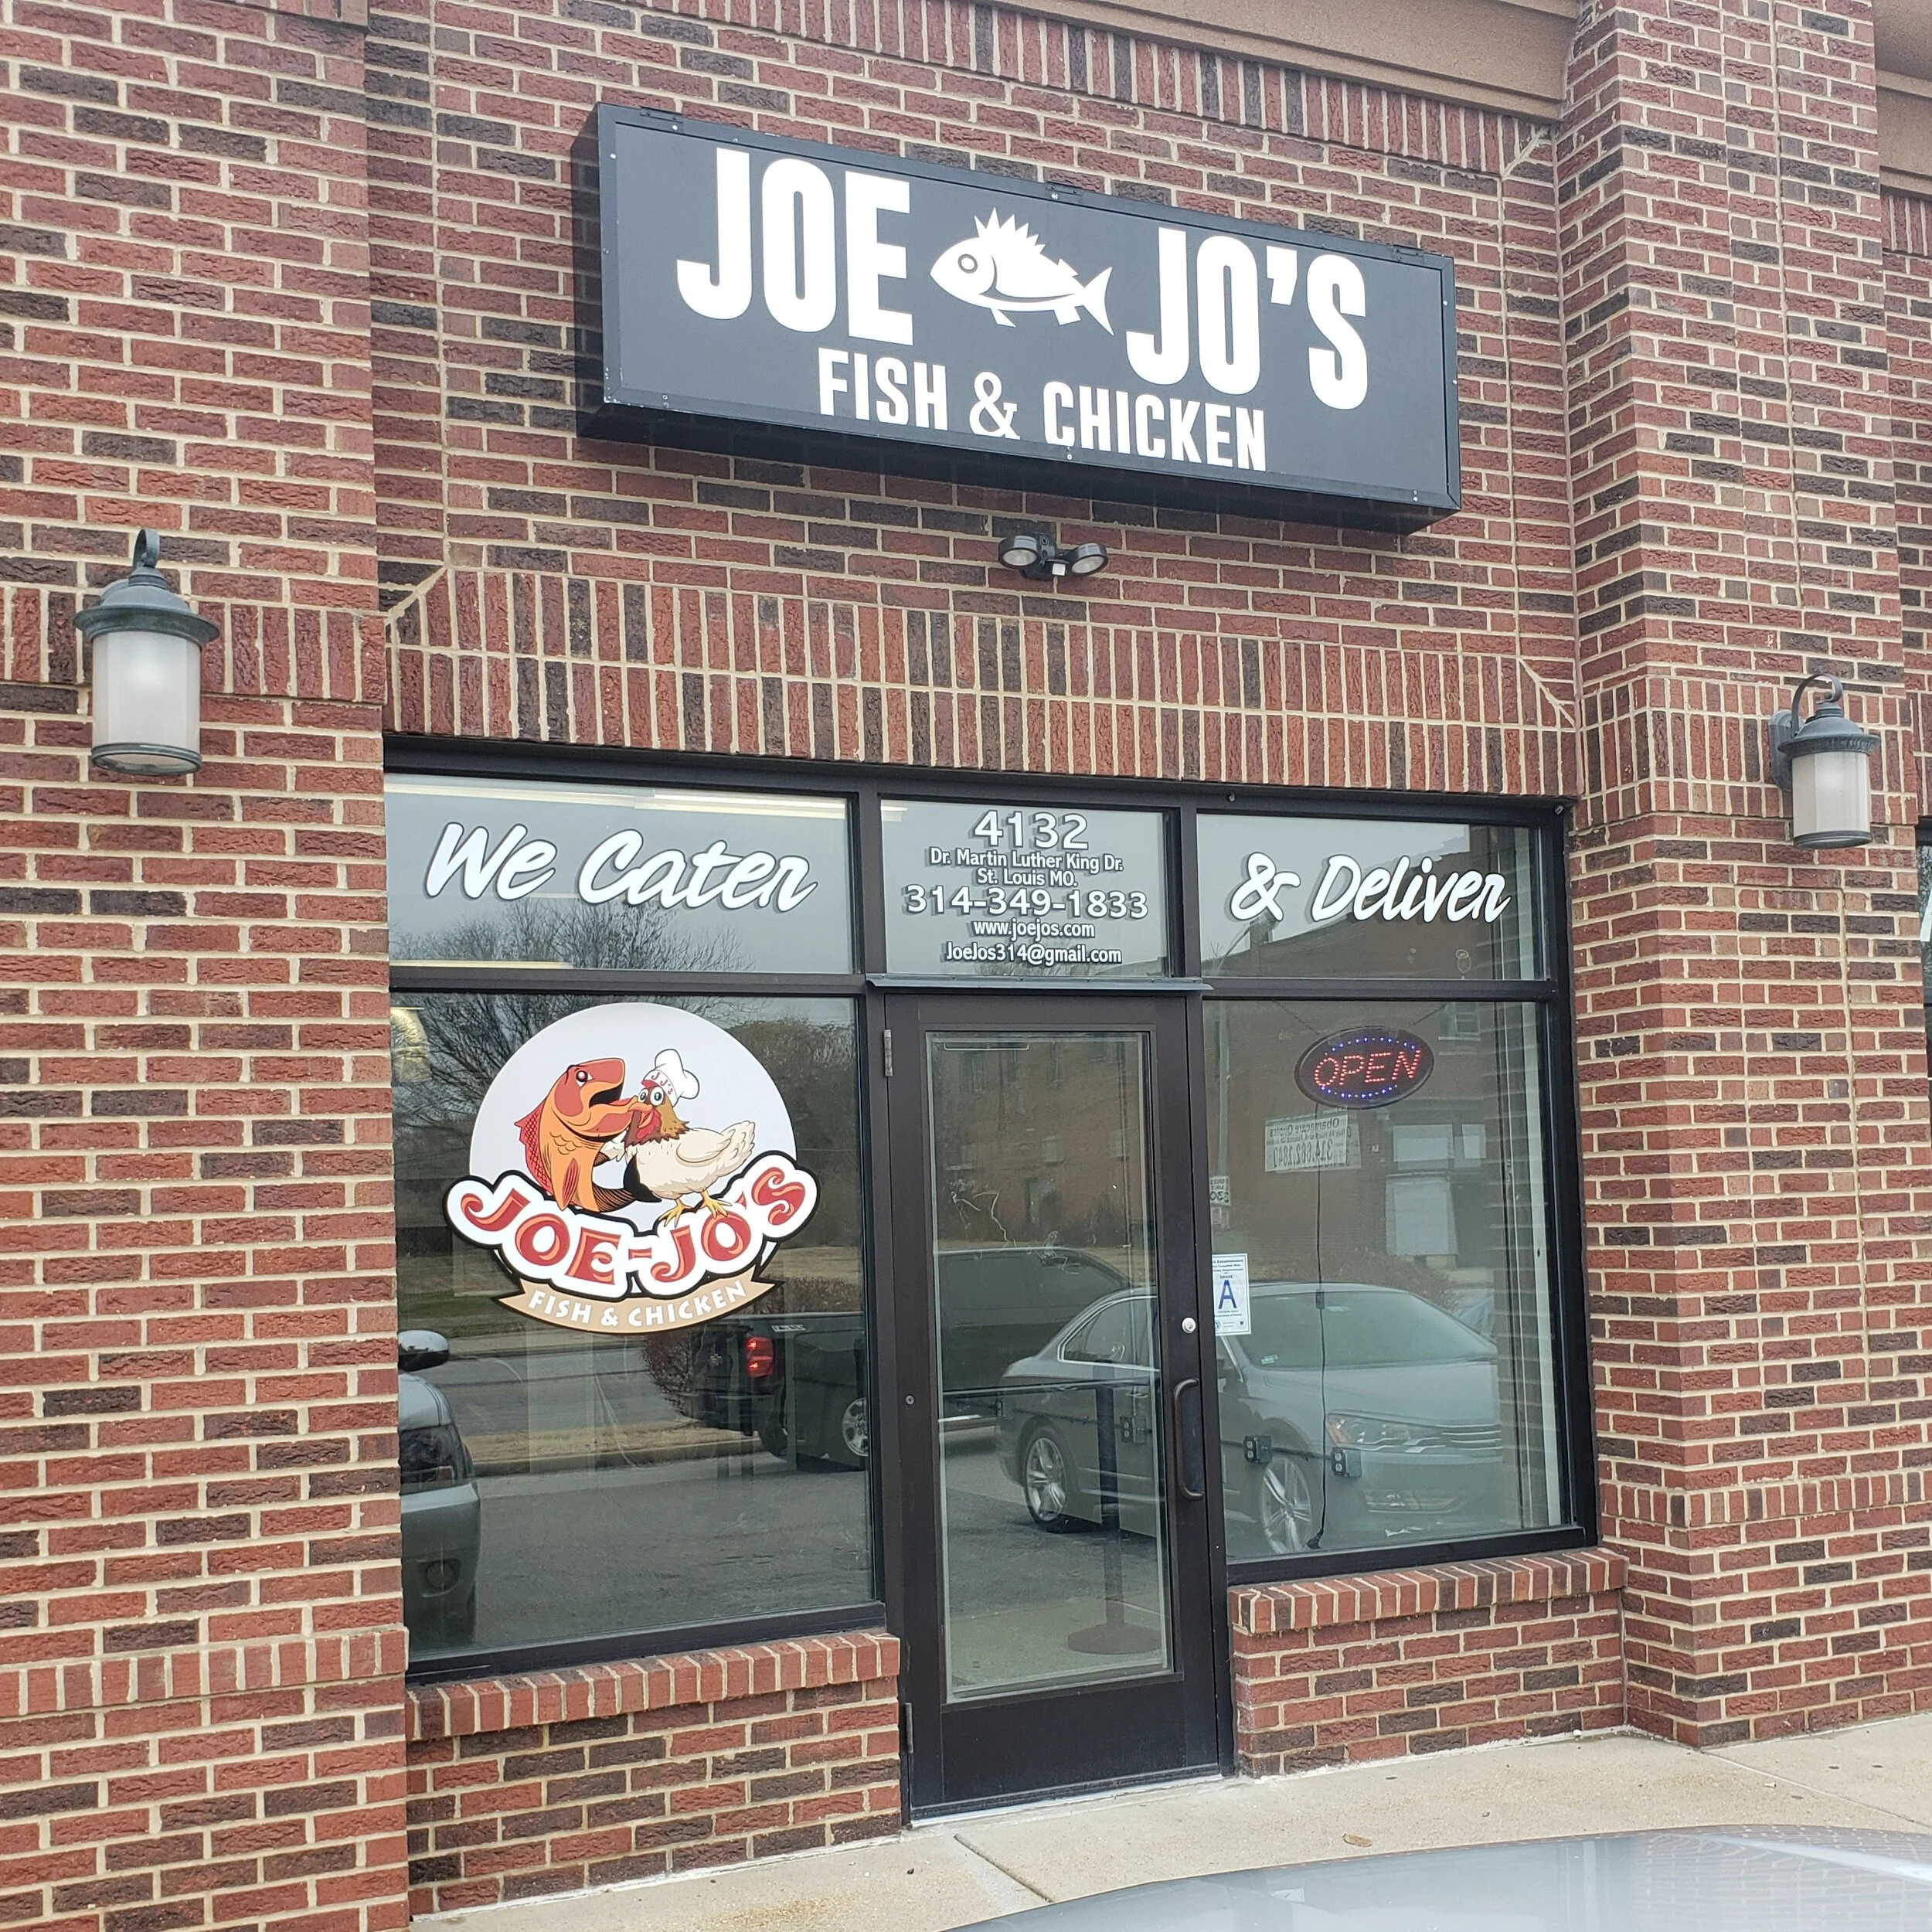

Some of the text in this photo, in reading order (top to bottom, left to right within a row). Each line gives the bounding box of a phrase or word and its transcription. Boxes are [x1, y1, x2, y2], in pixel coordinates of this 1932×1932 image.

[677, 148, 1368, 410] JOE JO'S
[818, 347, 1266, 471] FISH & CHICKEN
[972, 810, 1089, 850] 4132
[424, 821, 818, 913] We Cater
[930, 847, 1124, 874] Dr. Martin Luther King Dr.
[977, 868, 1079, 887] St. Louis MO.
[904, 884, 1149, 919] 314-349-1833
[1229, 852, 1512, 923] & Deliver
[972, 918, 1096, 942] www.joejos.com
[945, 941, 1123, 967] JoeJos314@gmail.com
[1315, 1050, 1422, 1089] OPEN
[461, 1165, 806, 1285] JOE-JO'S
[528, 1281, 747, 1327] FISH & CHICKEN
[1218, 1280, 1237, 1309] A
